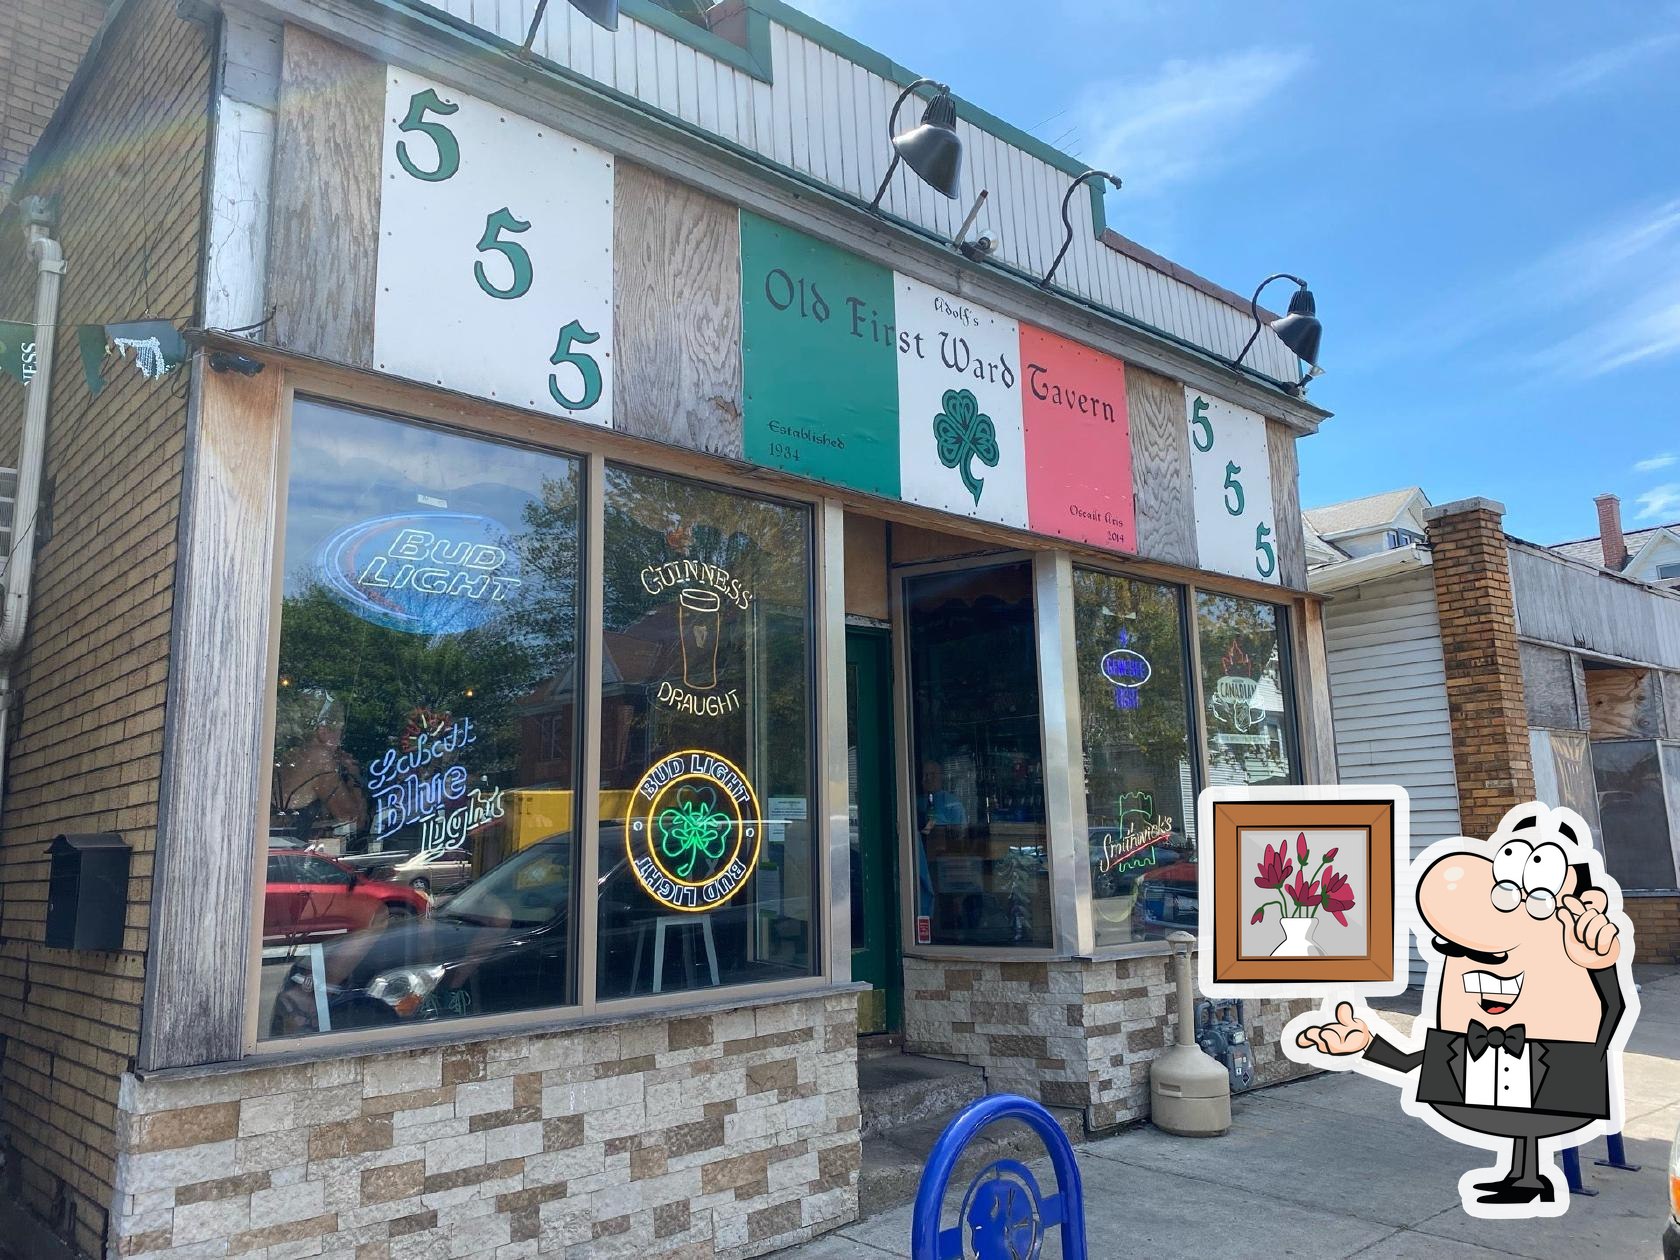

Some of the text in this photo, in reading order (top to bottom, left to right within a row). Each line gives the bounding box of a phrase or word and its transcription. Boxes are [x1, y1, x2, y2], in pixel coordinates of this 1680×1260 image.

[396, 88, 460, 182] 5
[474, 207, 533, 300] 5
[934, 296, 979, 327] Adolf's
[549, 319, 602, 410] 5
[765, 268, 1115, 423] Old First Ward Tavern
[768, 420, 845, 449] Established
[1192, 396, 1214, 452] 5
[769, 442, 800, 461] 1934
[1224, 459, 1244, 516] 5
[388, 529, 505, 570] BUD
[1255, 521, 1275, 578] 5
[357, 557, 522, 601] LIGHT
[641, 560, 752, 610] GUINNESS
[657, 681, 740, 716] DRAUGHT
[372, 766, 467, 840] Blue
[640, 754, 750, 803] BUD LIGHT
[1100, 815, 1173, 873] Smithwick's
[634, 857, 746, 907] BUD LIGHT
